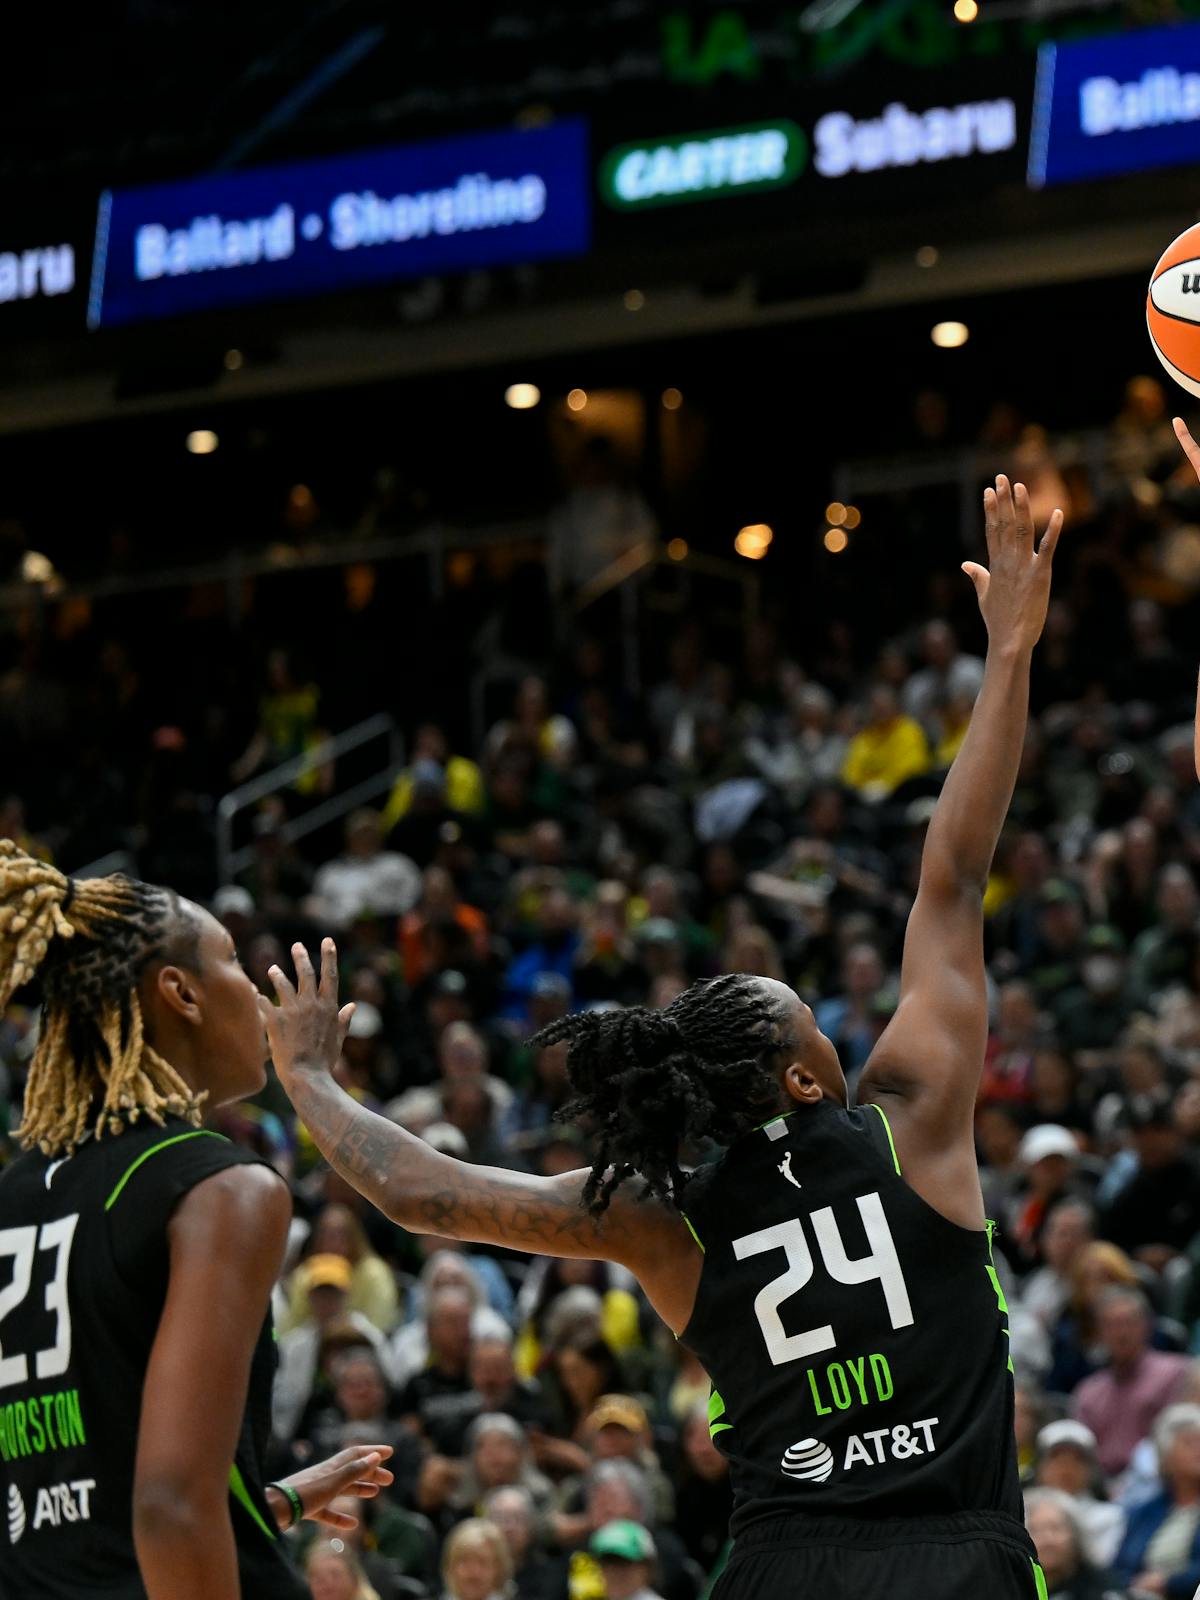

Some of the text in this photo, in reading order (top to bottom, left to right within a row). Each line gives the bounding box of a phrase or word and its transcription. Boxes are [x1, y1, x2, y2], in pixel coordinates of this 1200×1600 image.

[616, 99, 1017, 200] CARTER Subaru
[136, 174, 546, 280] Ballard Shoreline
[0, 1213, 80, 1388] 23
[732, 1191, 915, 1366] 24
[806, 1353, 894, 1416] LOYD
[843, 1417, 939, 1471] AT&T
[32, 1478, 97, 1530] AT&T
